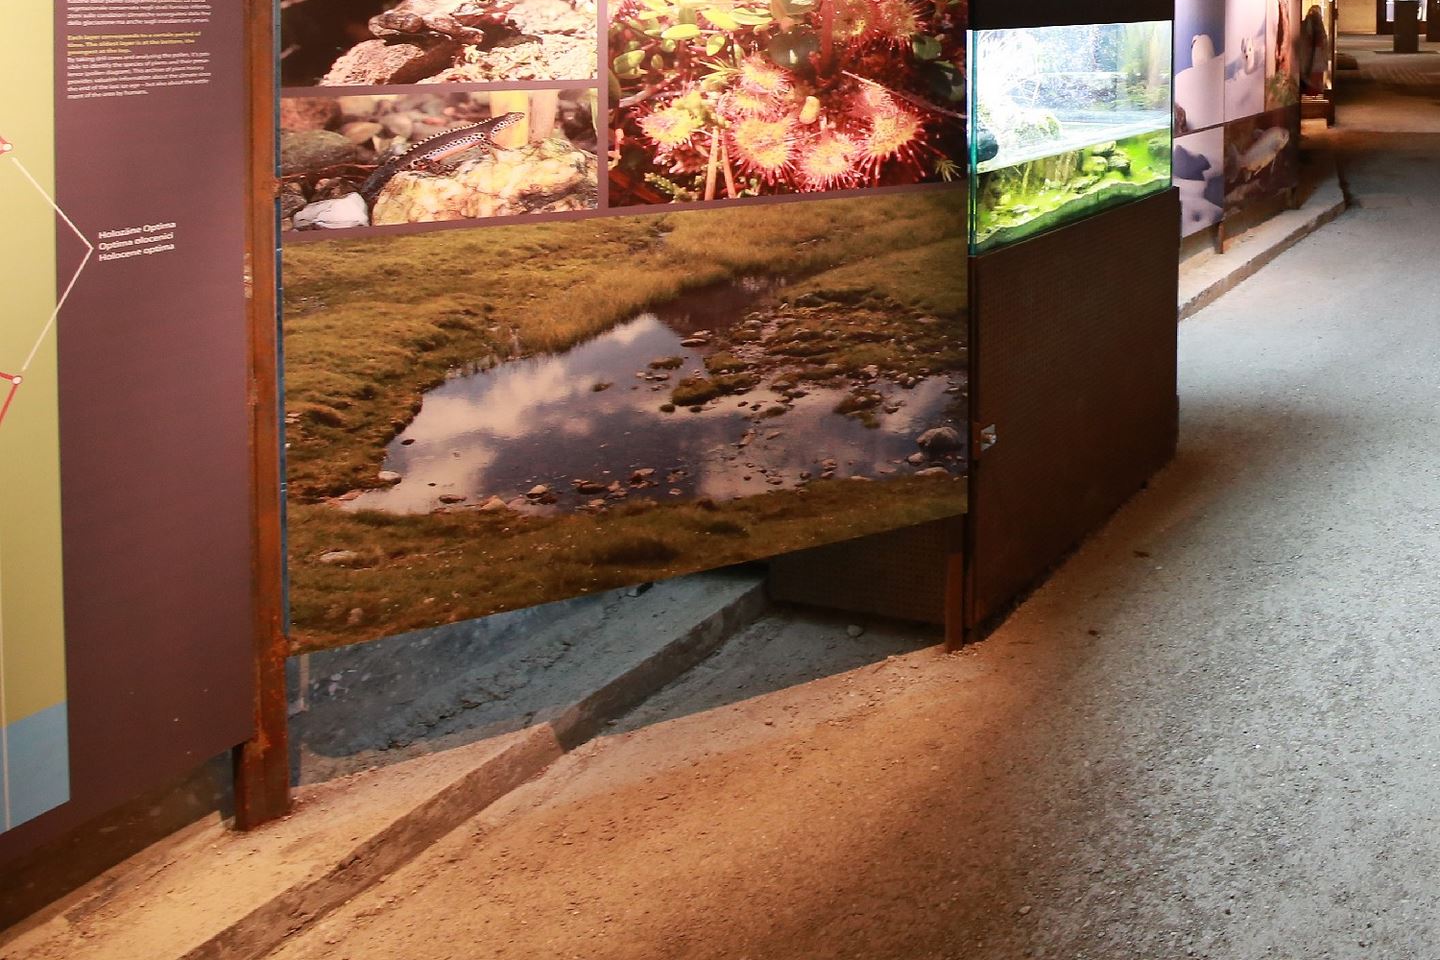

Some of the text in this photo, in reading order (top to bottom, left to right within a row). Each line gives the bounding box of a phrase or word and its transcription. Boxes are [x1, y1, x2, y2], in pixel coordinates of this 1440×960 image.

[143, 222, 176, 232] Optima
[98, 232, 174, 250] Optima olocenici
[98, 244, 175, 261] Holocene optima
